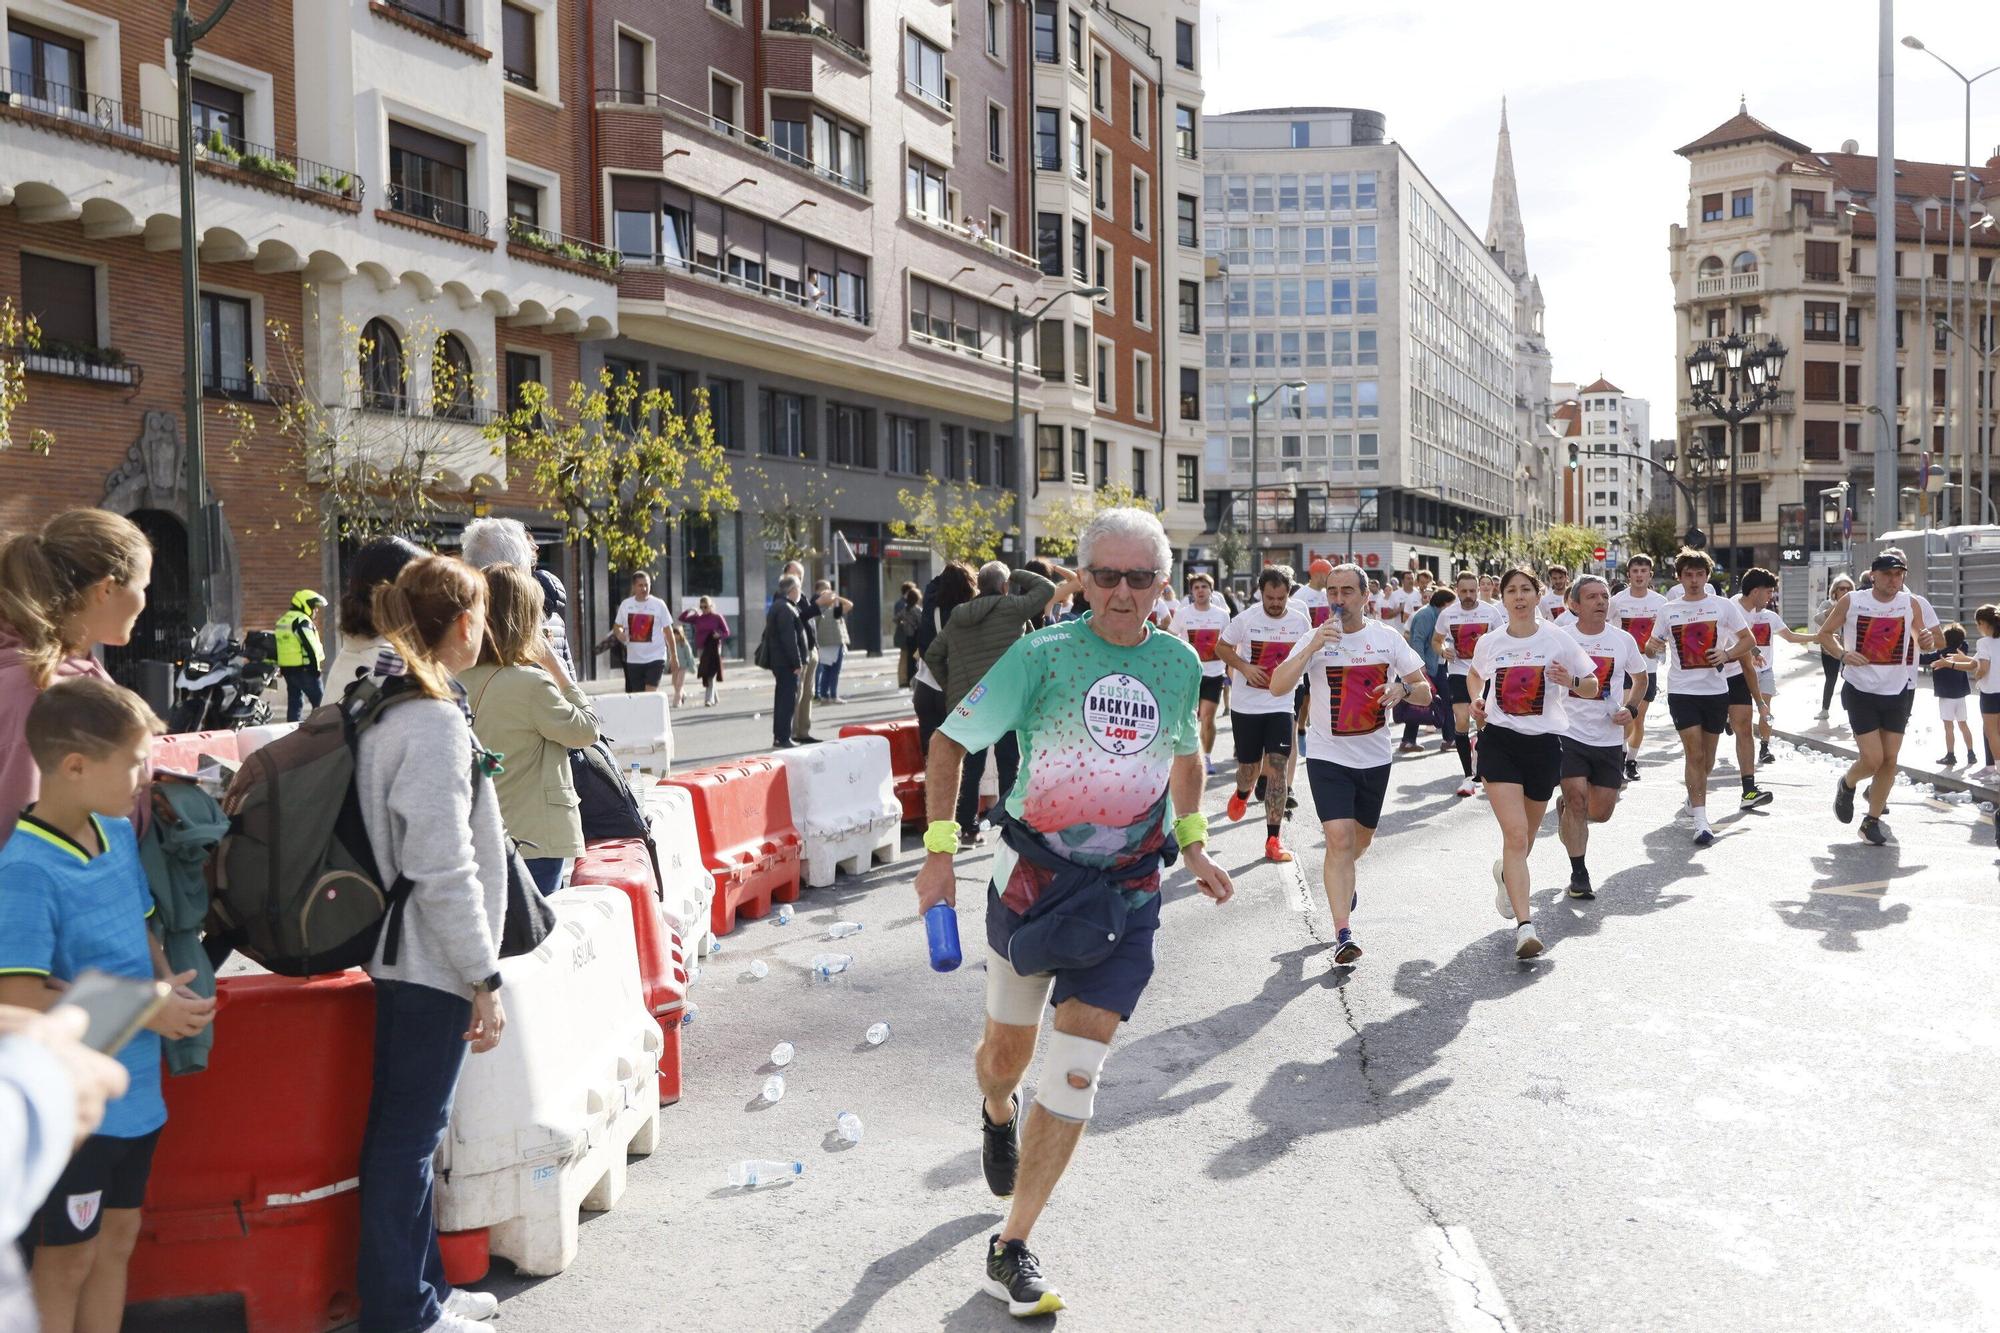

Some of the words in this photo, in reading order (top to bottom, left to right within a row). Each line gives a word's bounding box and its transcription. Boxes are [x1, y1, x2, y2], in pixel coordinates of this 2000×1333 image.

[1783, 550, 1801, 560] 19°C
[1099, 685, 1147, 702] EUSKAL
[1090, 696, 1155, 720] BACKYARD
[1109, 716, 1136, 728] ULTRA
